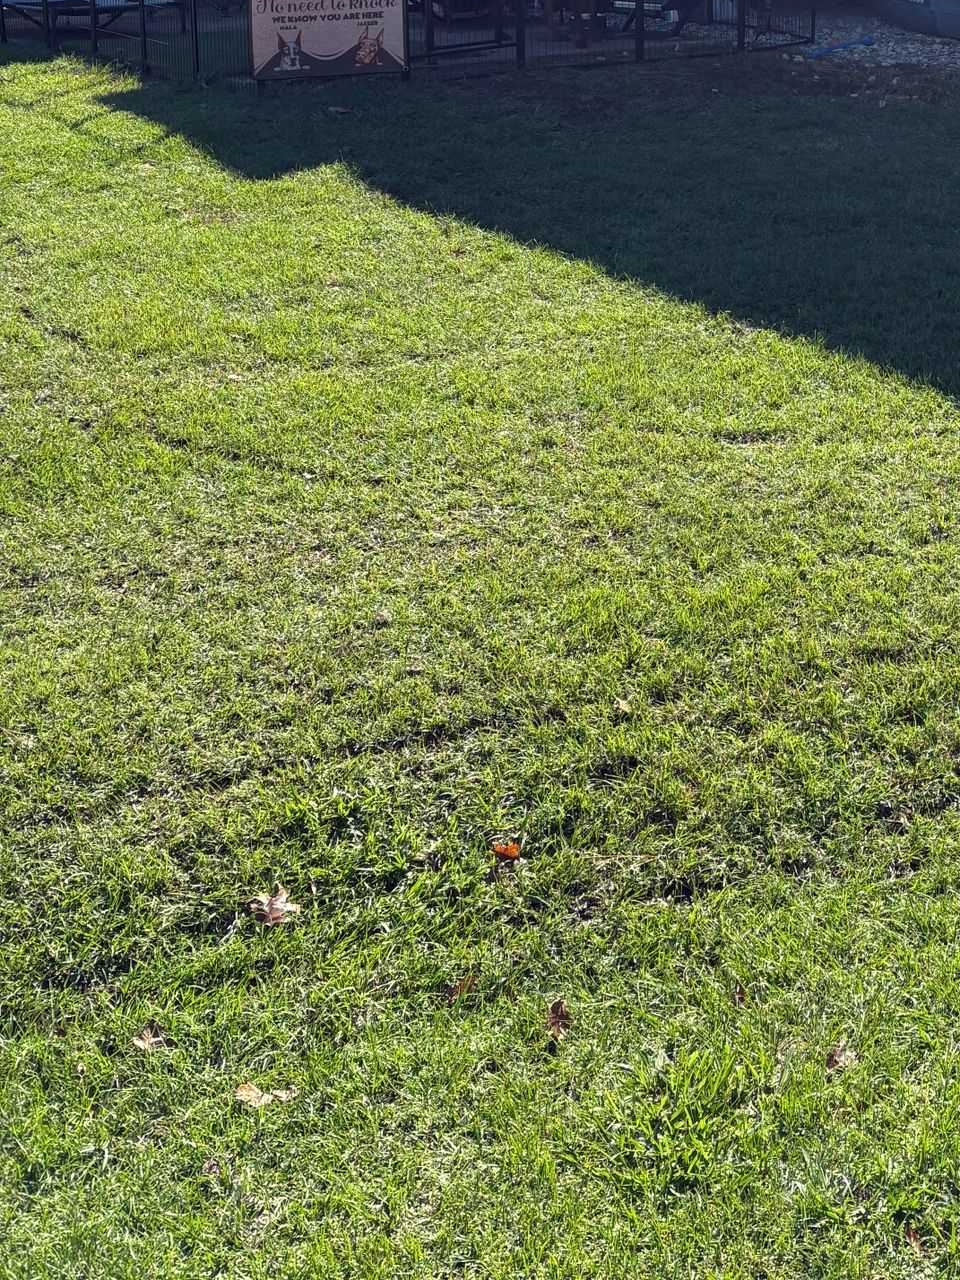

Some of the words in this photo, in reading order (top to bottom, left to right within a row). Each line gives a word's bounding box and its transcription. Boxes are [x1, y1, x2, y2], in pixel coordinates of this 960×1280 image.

[272, 16, 287, 24] WE
[287, 15, 318, 24] KNOW
[319, 13, 341, 22] YOU
[343, 12, 361, 20] ARE
[361, 11, 385, 19] HERE
